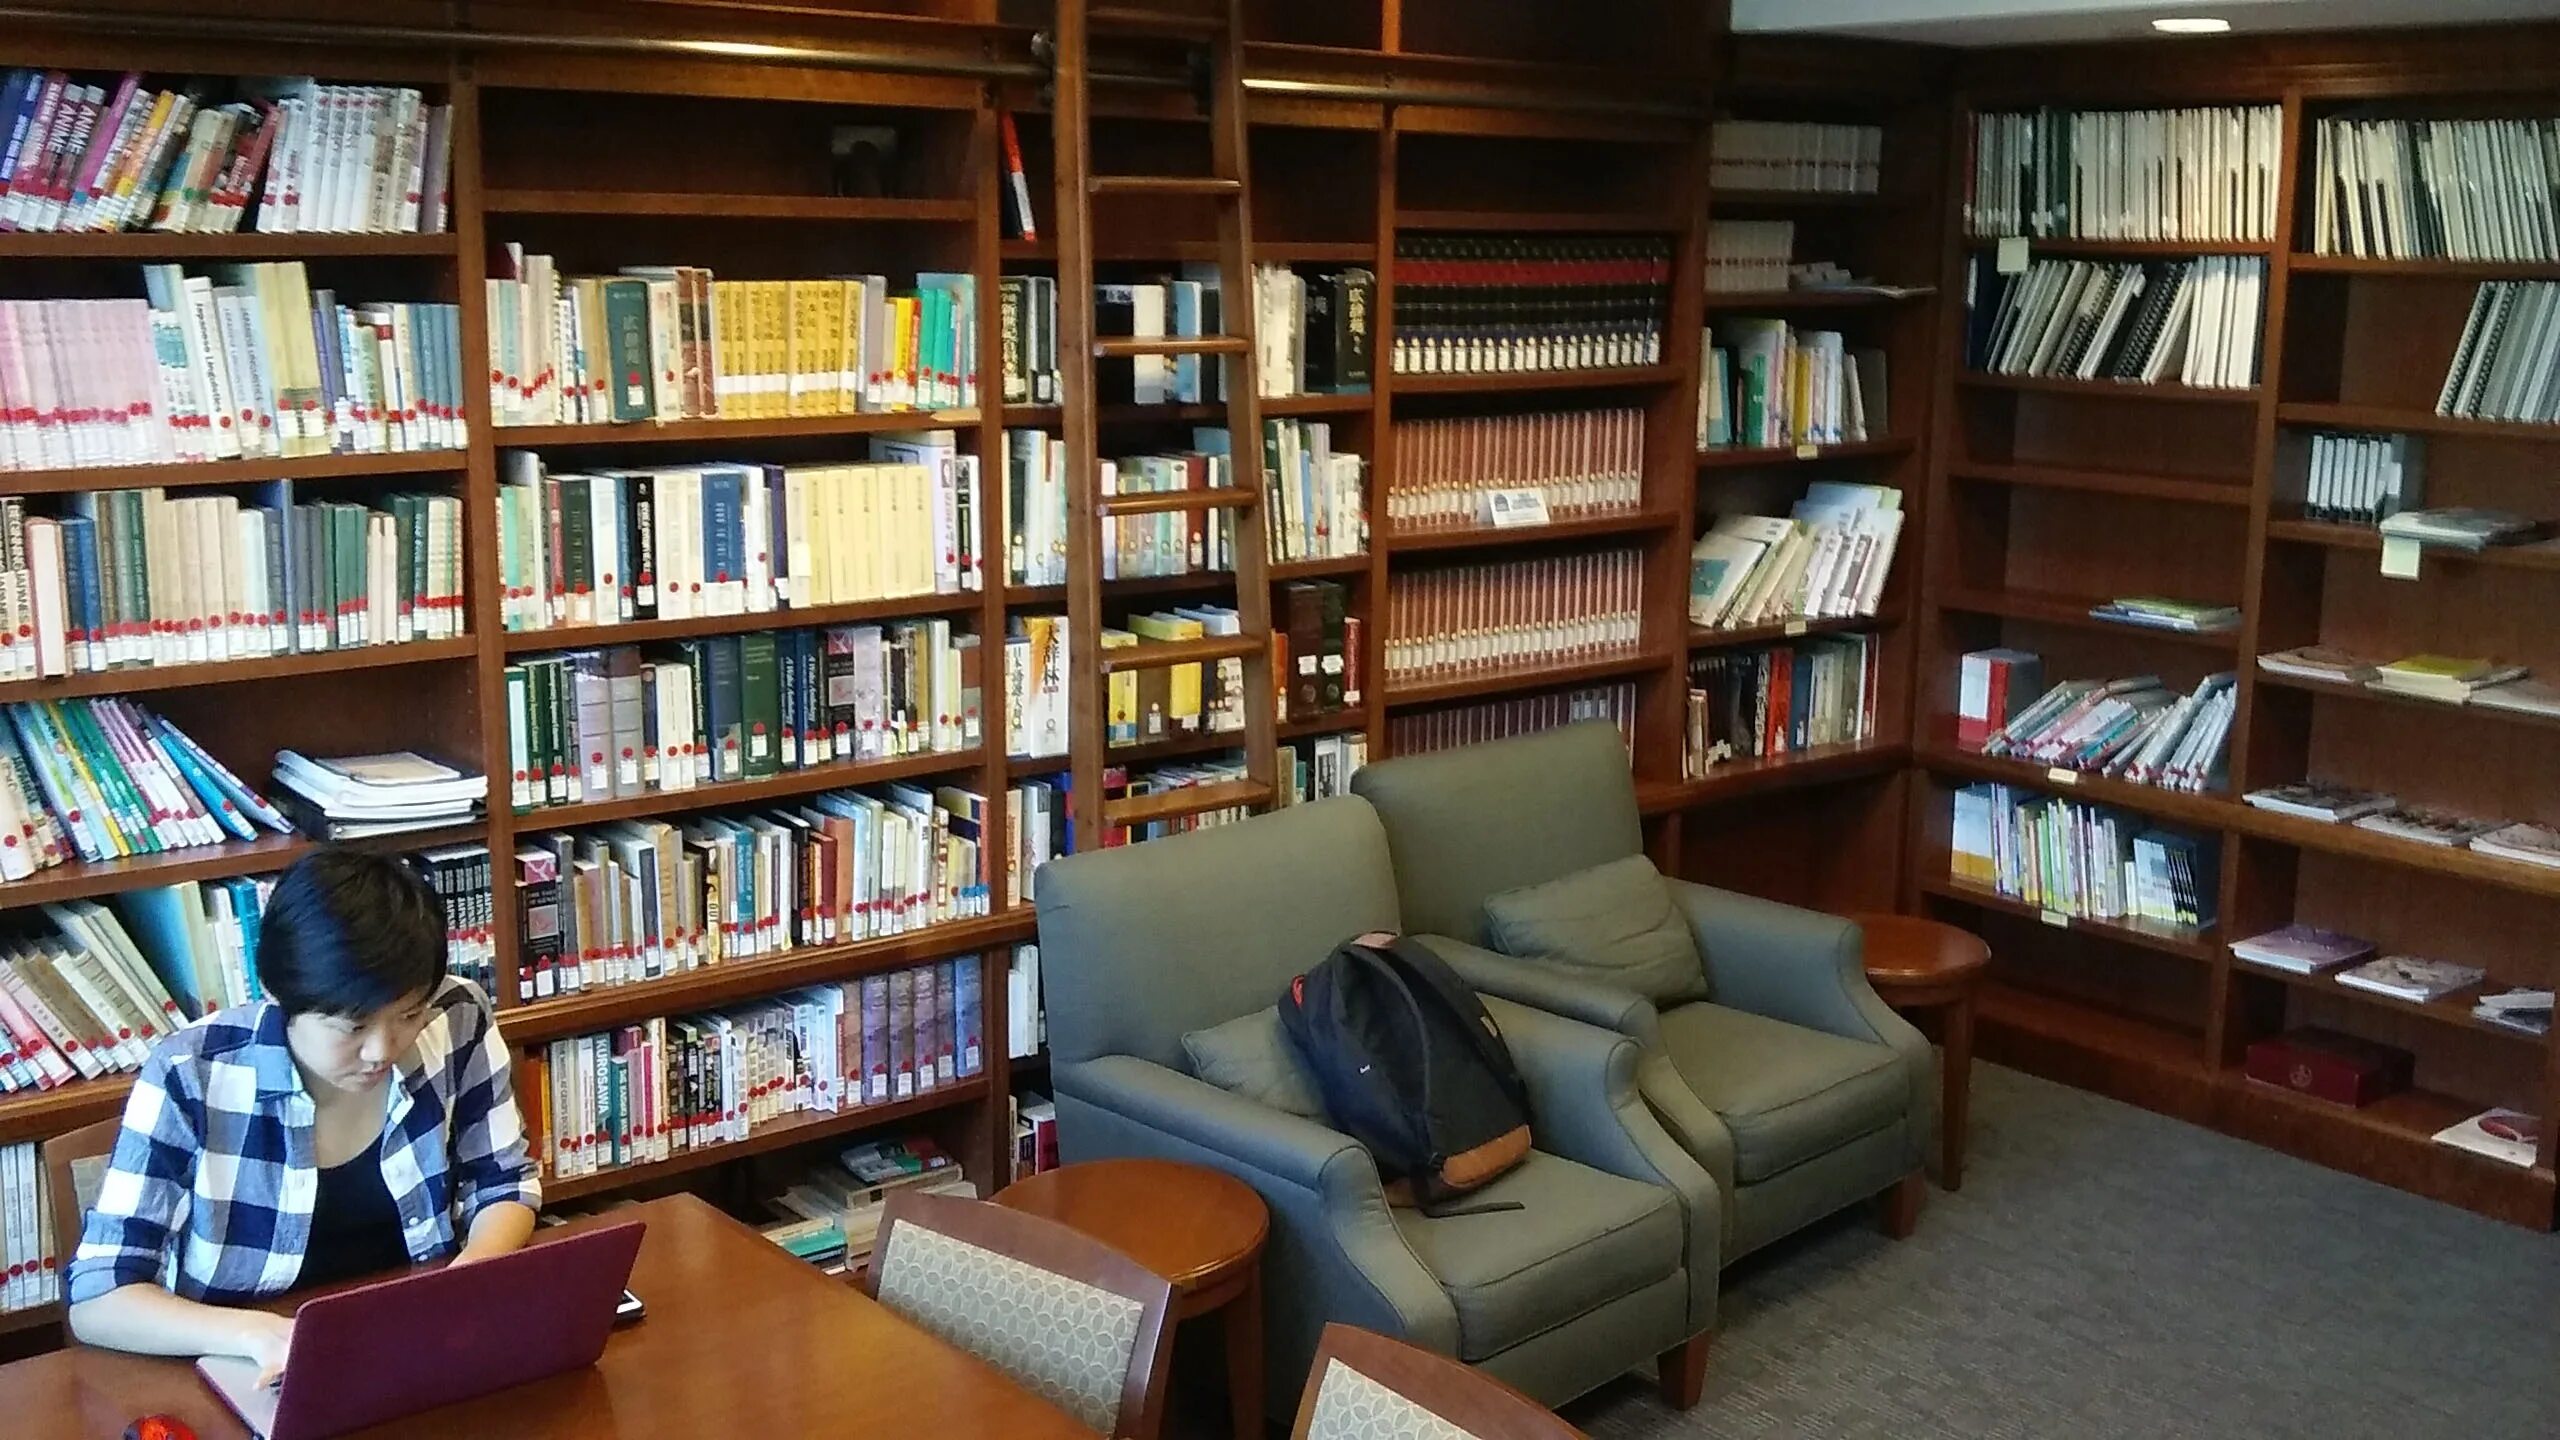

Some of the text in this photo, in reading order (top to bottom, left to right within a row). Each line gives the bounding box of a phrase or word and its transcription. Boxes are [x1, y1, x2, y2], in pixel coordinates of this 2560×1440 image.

[45, 103, 78, 154] ANIME
[67, 105, 97, 155] ANIME
[195, 303, 223, 413] Japanese Linguistics
[1042, 623, 1061, 687] 大辞林
[596, 1038, 610, 1114] KUROSAWA
